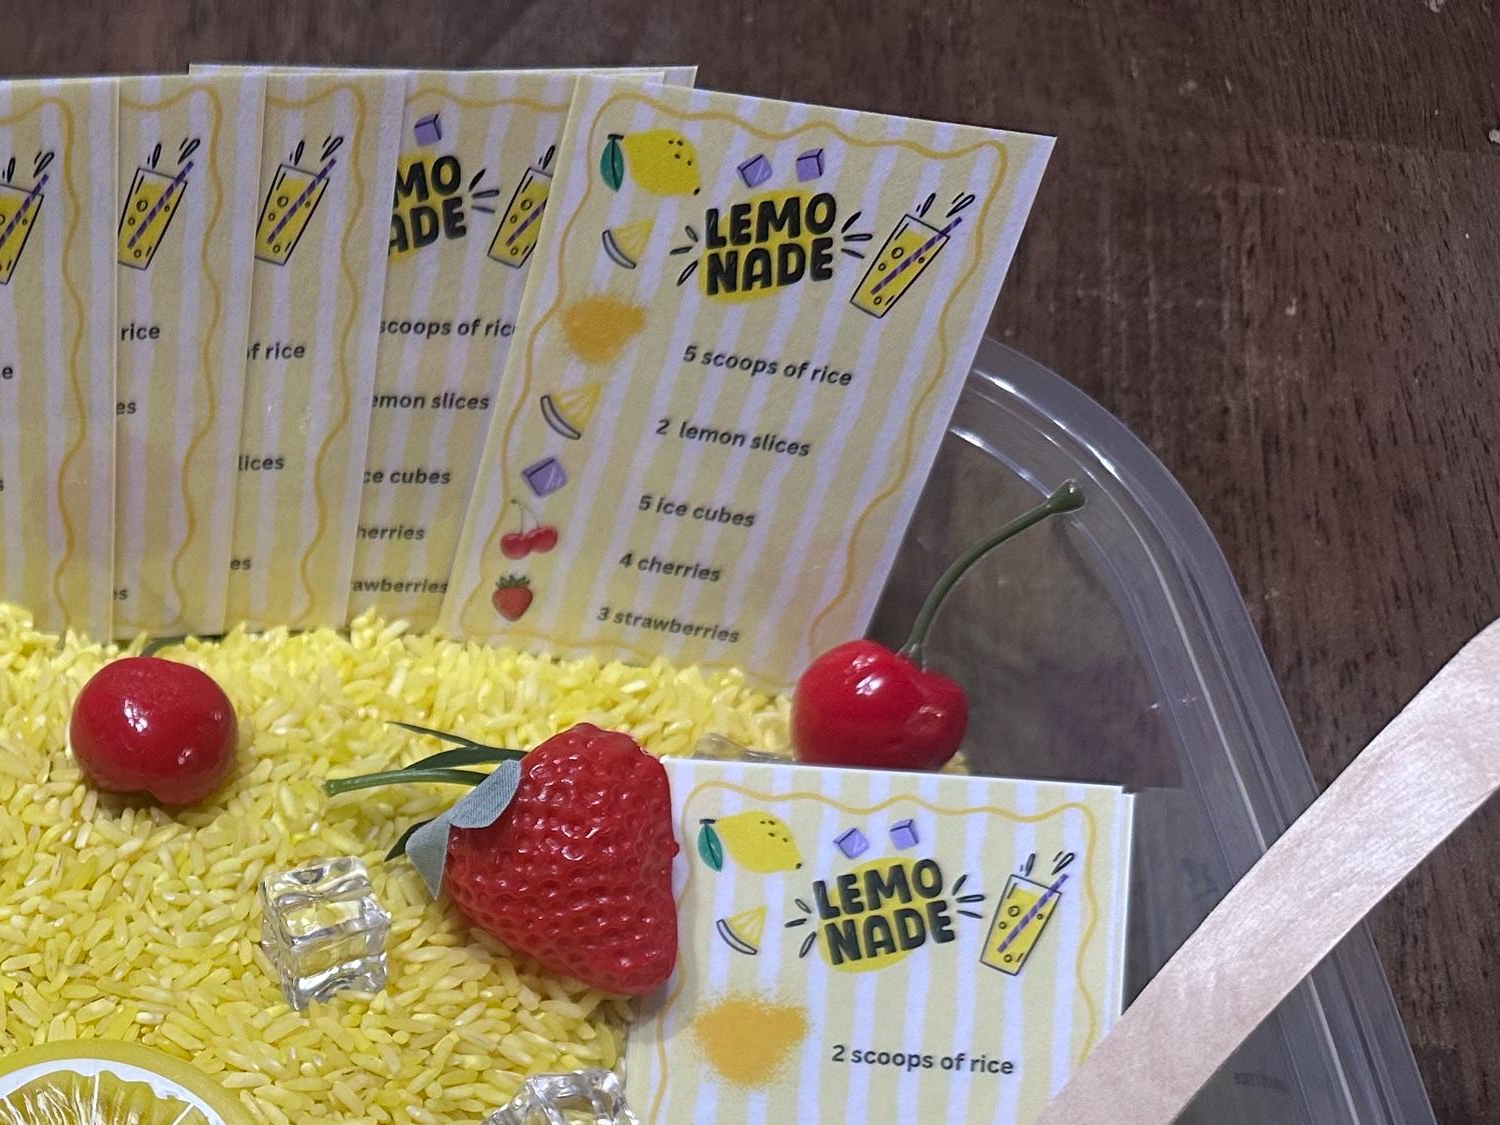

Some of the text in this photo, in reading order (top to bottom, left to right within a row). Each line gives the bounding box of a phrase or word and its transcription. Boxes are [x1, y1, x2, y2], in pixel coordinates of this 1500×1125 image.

[388, 196, 467, 256] ADE
[705, 192, 837, 249] LEMO
[706, 237, 834, 295] NADE
[120, 322, 161, 341] rice
[457, 318, 481, 336] of
[484, 319, 515, 337] ric
[265, 342, 305, 360] rice
[683, 345, 853, 387] 5 scoops of rice
[431, 392, 489, 410] slices
[656, 418, 811, 458] 2 lemon slices
[238, 455, 284, 471] lices
[390, 468, 451, 484] cubes
[639, 494, 755, 529] 5 ice cubes
[356, 525, 425, 540] herries
[619, 552, 722, 583] 4 cherries
[597, 606, 740, 645] 3 strawberries
[812, 859, 943, 921] LEMO
[824, 900, 956, 966] NADE
[831, 1043, 1014, 1076] 2 scoops of rice
